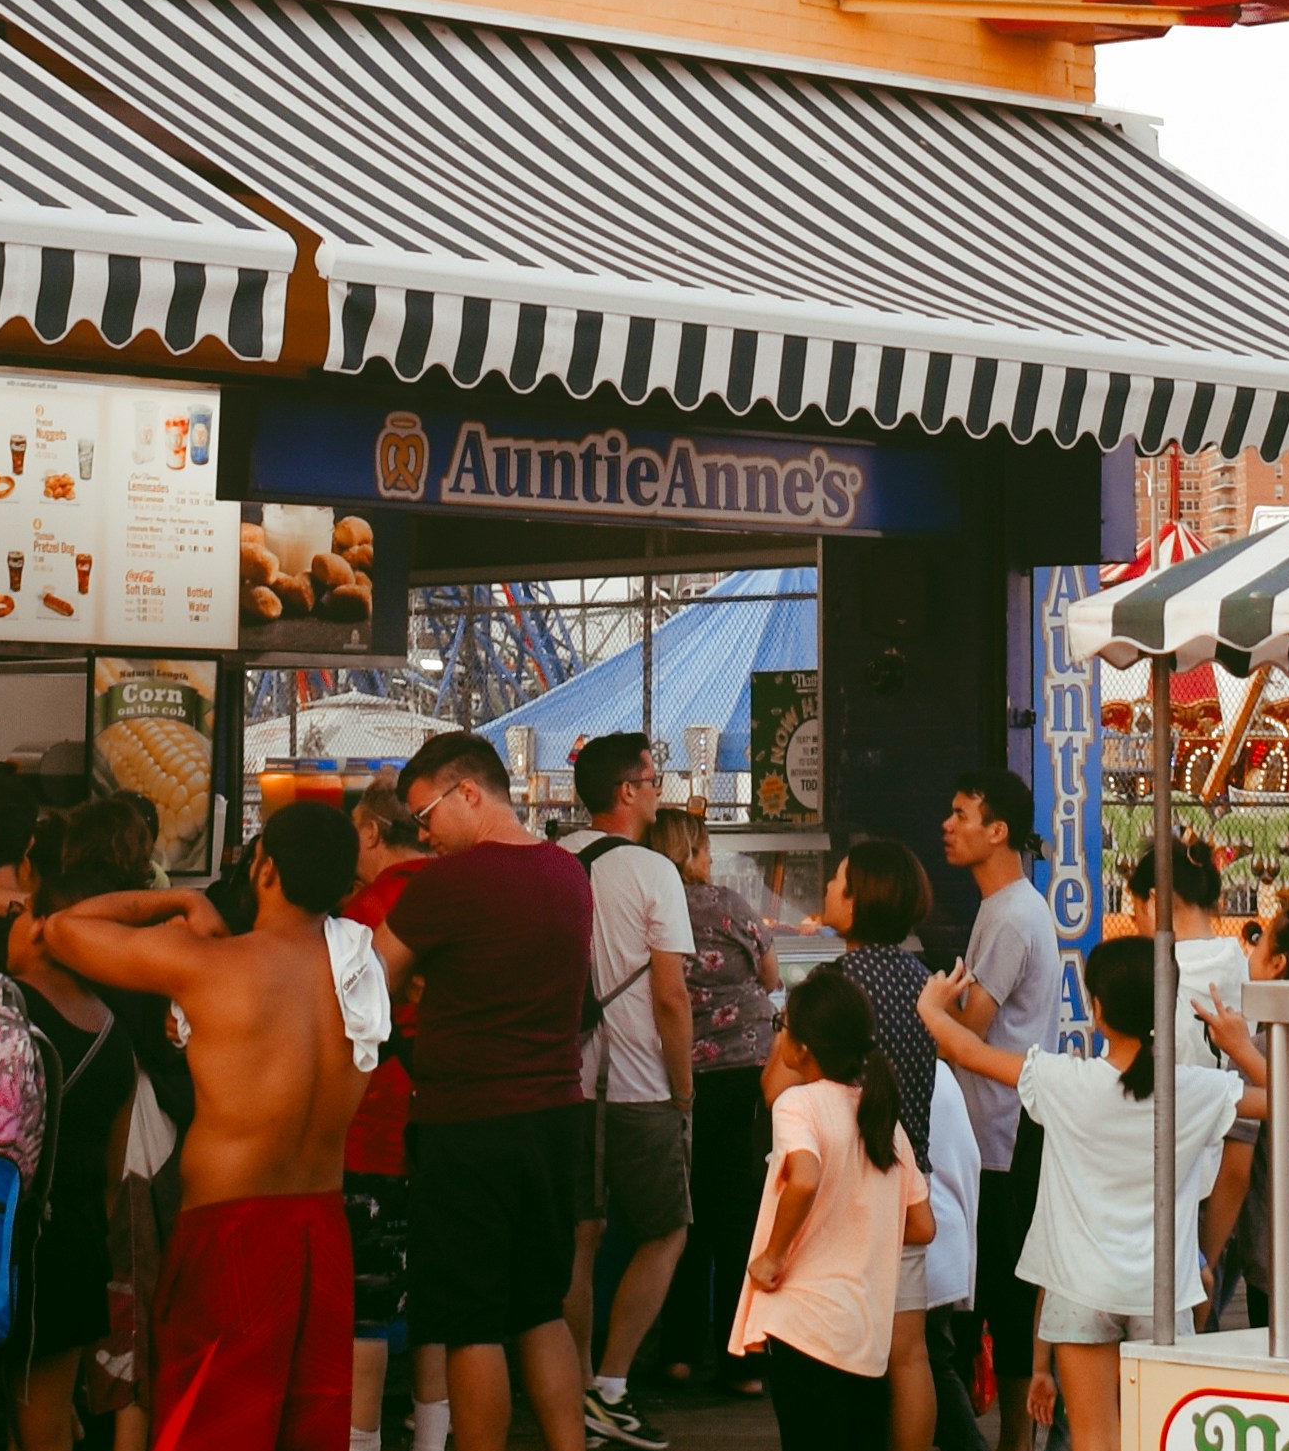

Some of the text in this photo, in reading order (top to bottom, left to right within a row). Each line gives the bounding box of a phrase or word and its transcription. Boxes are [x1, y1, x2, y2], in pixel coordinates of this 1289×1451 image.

[36, 428, 67, 442] Nuggets
[33, 540, 60, 554] Pretzel
[61, 542, 76, 557] Dog
[125, 584, 212, 598] Soft Drinks Bottled
[189, 602, 210, 612] Water
[119, 669, 189, 681] Natural Length
[122, 683, 183, 704] Corn
[118, 703, 186, 718] on the cob
[771, 706, 799, 765] NOW
